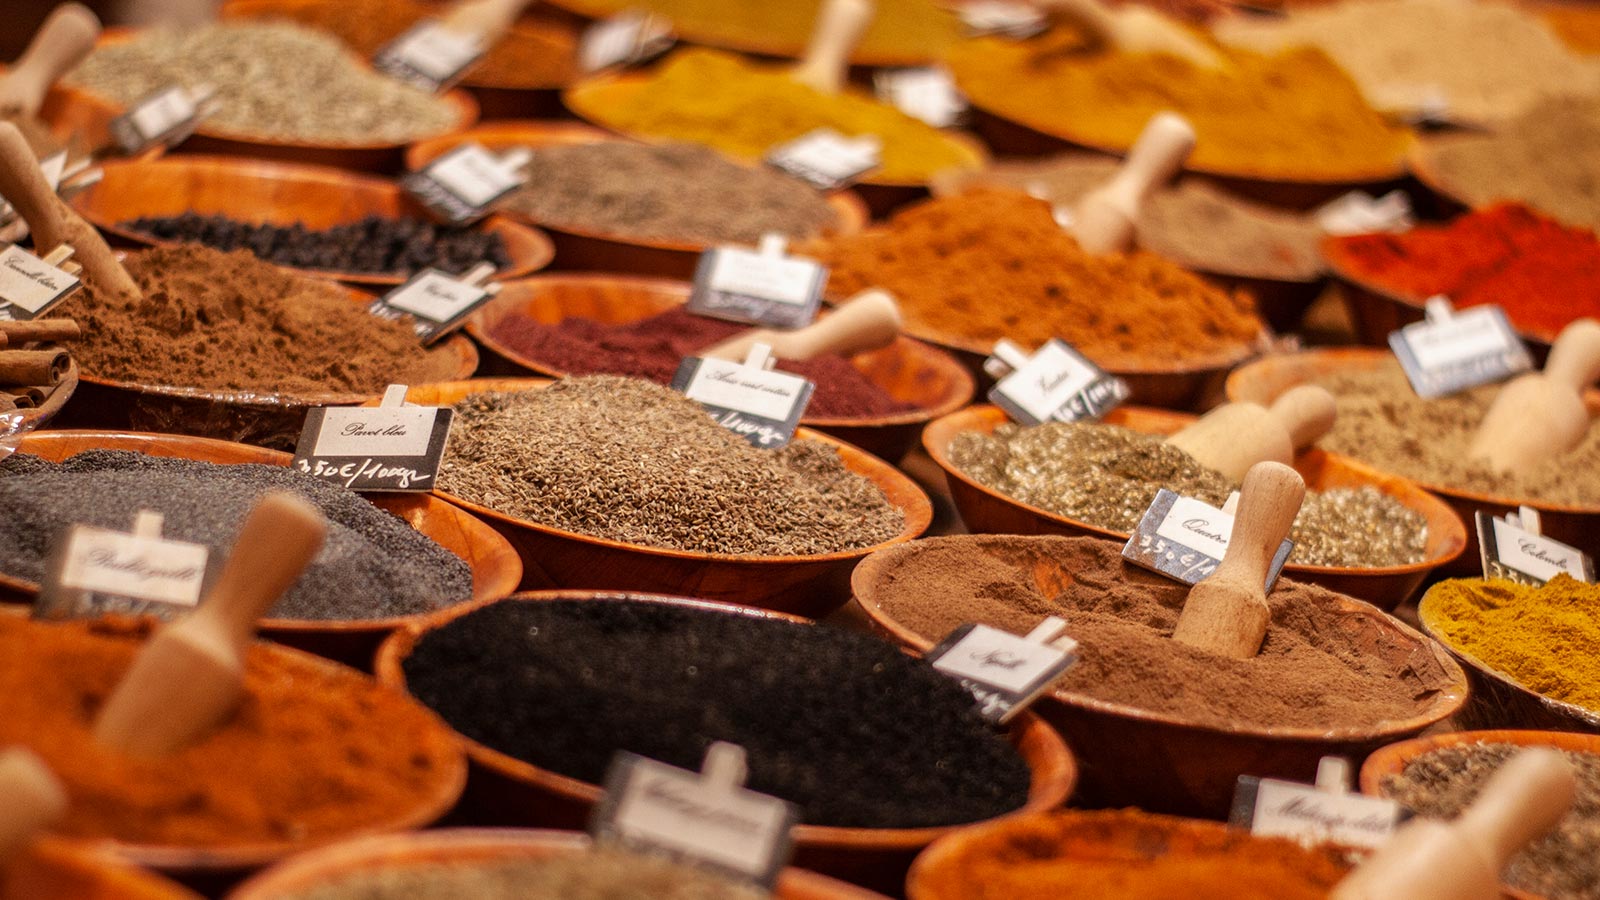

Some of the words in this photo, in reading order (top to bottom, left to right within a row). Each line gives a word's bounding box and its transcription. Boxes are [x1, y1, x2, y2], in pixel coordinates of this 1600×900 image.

[340, 422, 381, 437] Pavot
[382, 424, 407, 437] bleu
[1181, 517, 1228, 545] Quatre
